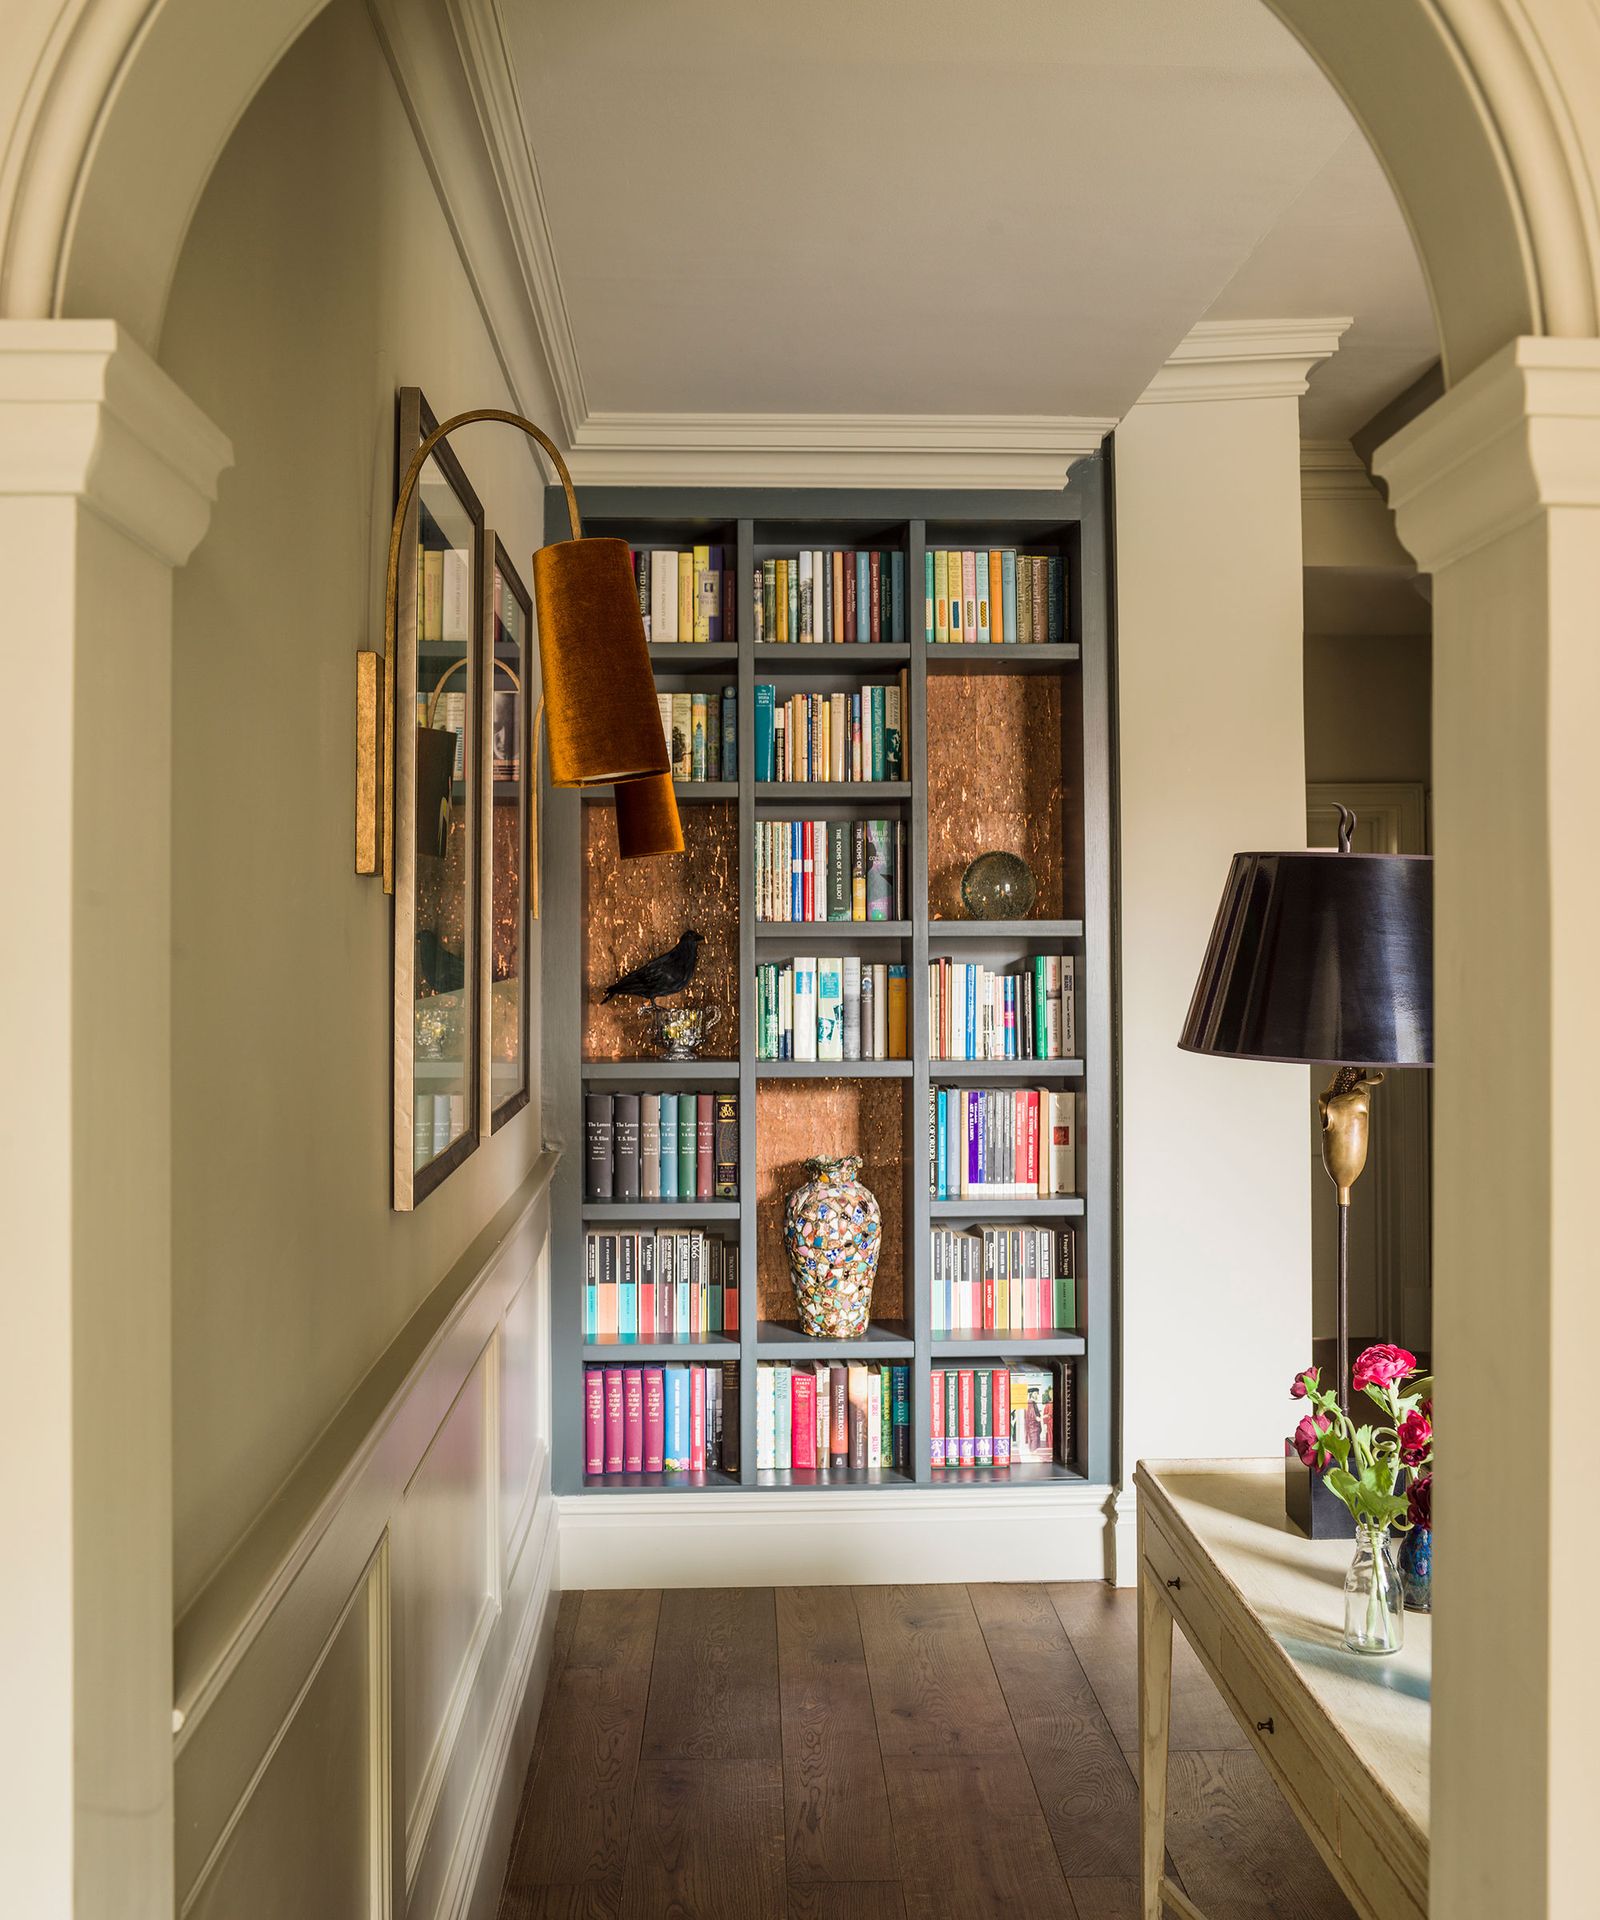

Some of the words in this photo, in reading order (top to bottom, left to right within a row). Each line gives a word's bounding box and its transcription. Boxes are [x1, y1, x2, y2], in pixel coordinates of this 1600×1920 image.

[874, 689, 883, 707] Sylvia
[836, 861, 842, 870] OF
[856, 861, 862, 869] OF
[929, 1125, 936, 1135] OF
[1028, 1136, 1034, 1144] OF
[691, 1236, 700, 1259] 1066
